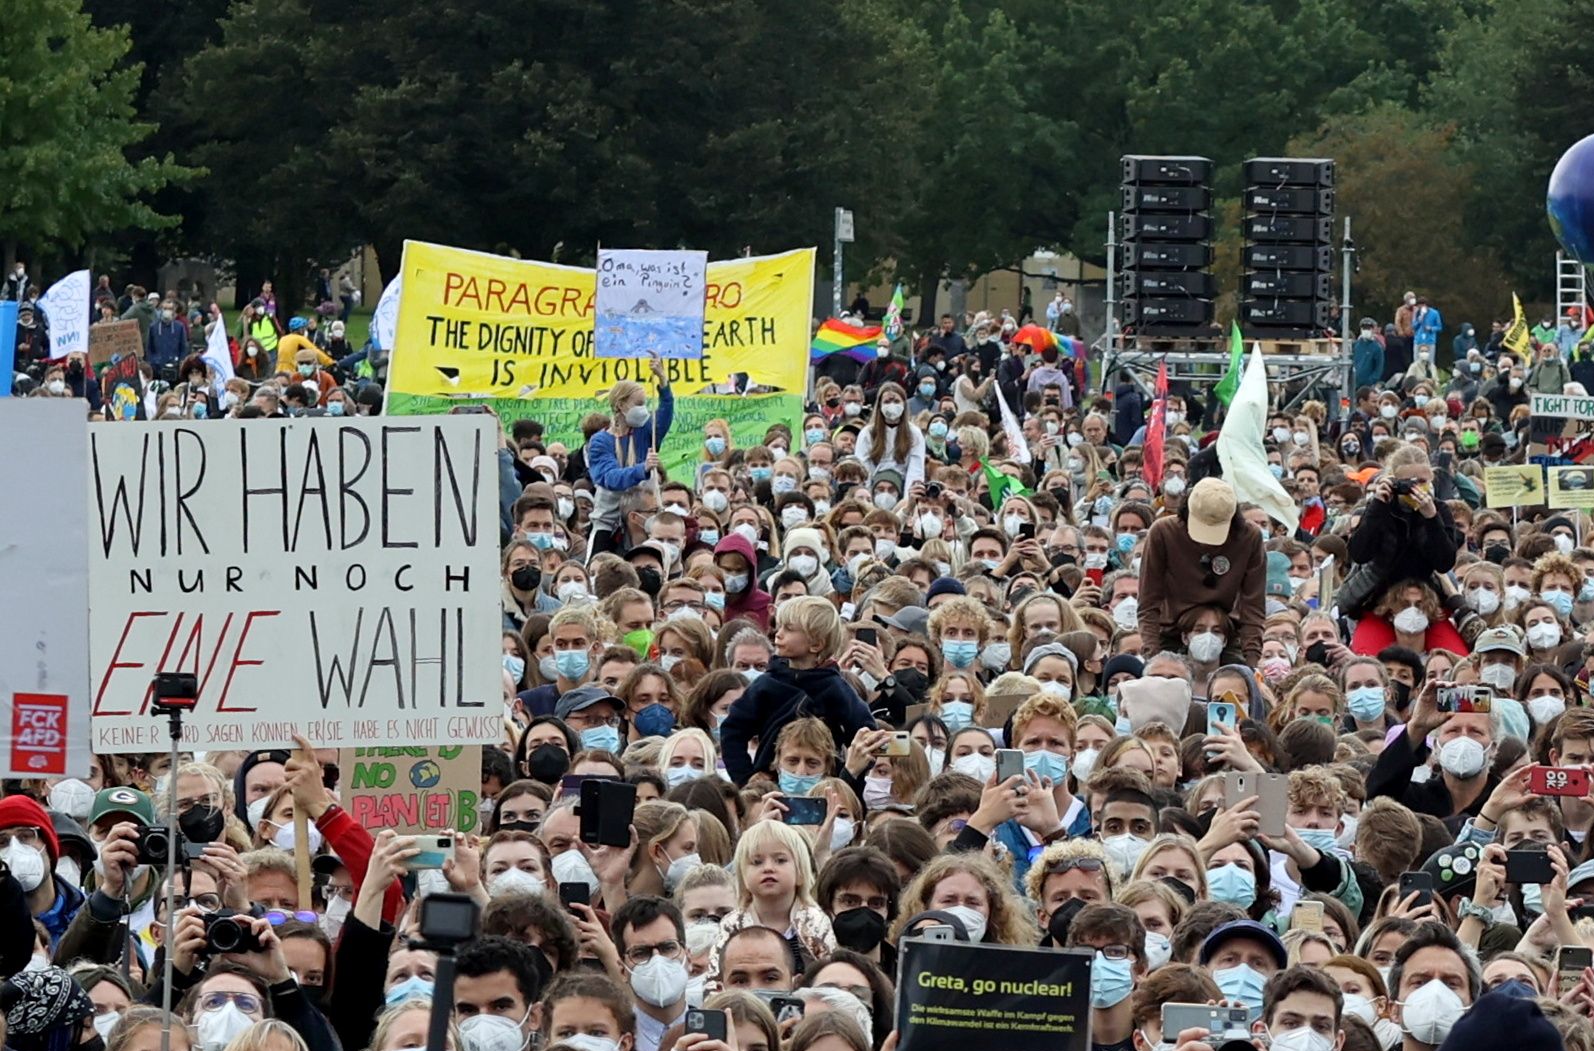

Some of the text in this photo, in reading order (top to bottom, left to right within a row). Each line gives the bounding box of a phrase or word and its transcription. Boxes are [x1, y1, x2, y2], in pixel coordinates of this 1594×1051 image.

[602, 274, 626, 287] ein
[667, 261, 686, 275] ist
[705, 281, 743, 309] RO
[426, 315, 471, 350] THE
[479, 322, 566, 356] DIGNITY
[572, 329, 595, 358] OF
[491, 359, 516, 386] IS
[1533, 396, 1568, 413] FIGHT
[90, 425, 482, 560] WIR HABEN
[130, 563, 471, 594] NUR NOCH
[91, 606, 486, 717] EINE WAHL
[19, 710, 62, 729] FCK
[206, 722, 244, 743] SAGEN
[307, 717, 344, 746] ER/SIE
[353, 718, 381, 740] HABE
[387, 720, 400, 739] ES
[405, 716, 440, 739] NICHT
[446, 714, 502, 740] GEWUSST
[17, 728, 61, 746] AFD
[350, 761, 397, 790] NO
[457, 789, 478, 833] B
[917, 970, 1073, 998] Greta, go nuclear!
[911, 1003, 925, 1013] Die
